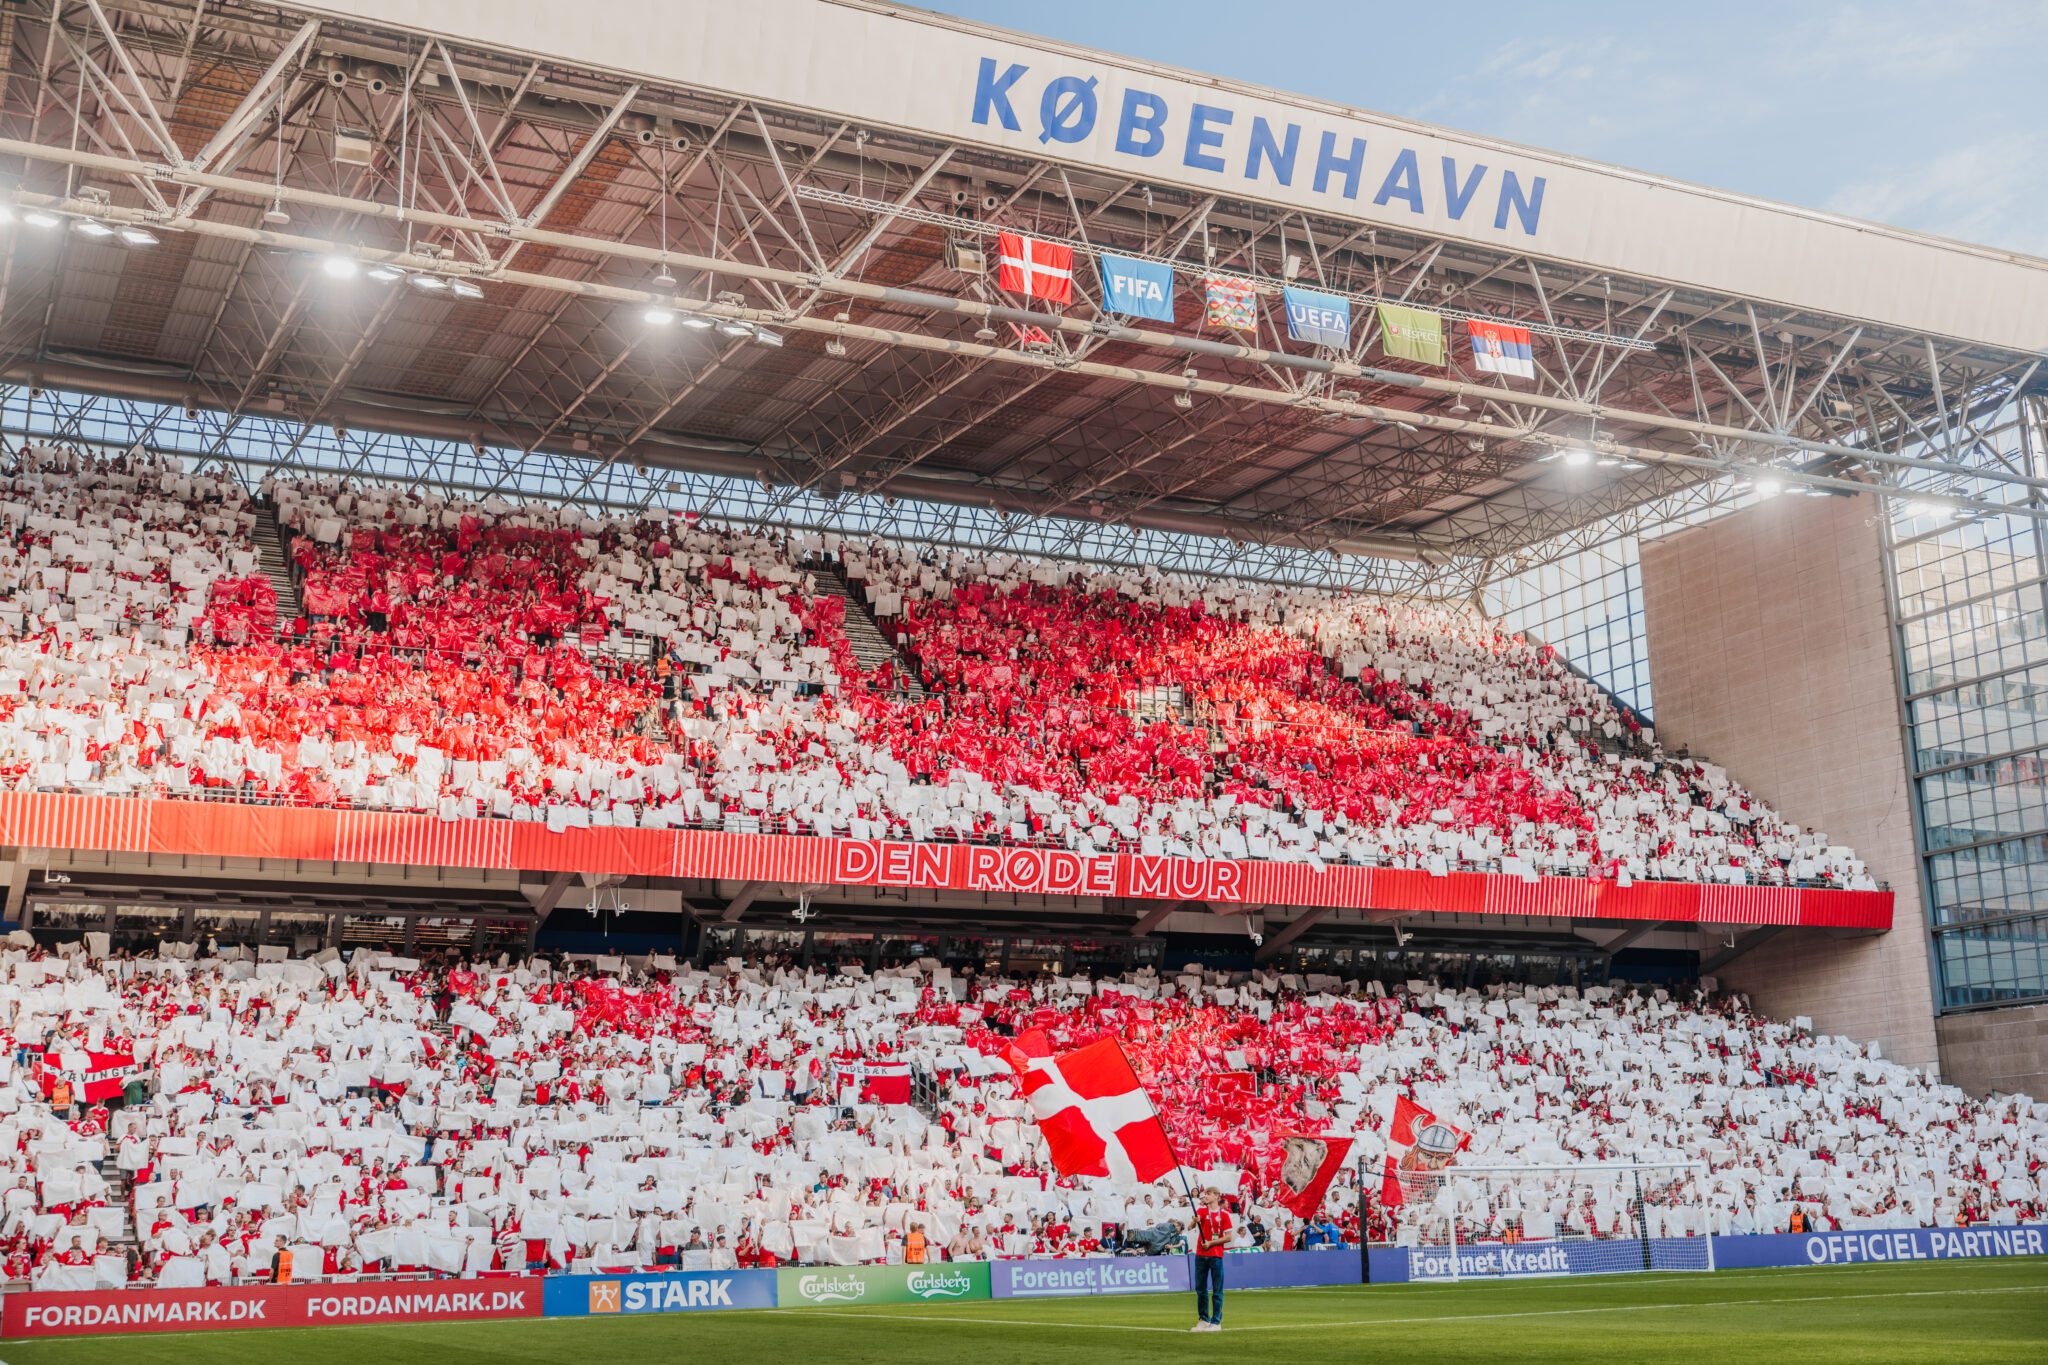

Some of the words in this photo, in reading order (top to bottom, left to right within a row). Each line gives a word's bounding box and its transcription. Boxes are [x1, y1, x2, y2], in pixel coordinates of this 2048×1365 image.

[971, 57, 1546, 236] KØBENHAVN
[1113, 274, 1163, 302] FIFA
[1290, 305, 1346, 332] UEFA
[1402, 327, 1438, 344] RESPECT
[835, 838, 952, 886] DEN
[968, 846, 1115, 896] RØDE
[1129, 855, 1242, 900] MUR
[1410, 1251, 1498, 1275] Forenet
[1501, 1246, 1569, 1272] Kredit
[1806, 1232, 1927, 1264] OFFICIEL
[1930, 1229, 2045, 1258] PARTNER
[799, 1274, 865, 1301] Carlsberg
[907, 1270, 971, 1297] Carlsberg
[1011, 1266, 1097, 1288] Forenet
[1100, 1262, 1169, 1286] Kredit
[306, 1290, 526, 1317] FORDANMARK.DK
[624, 1278, 733, 1310] STARK
[25, 1299, 266, 1328] FORDANMARK.DK
